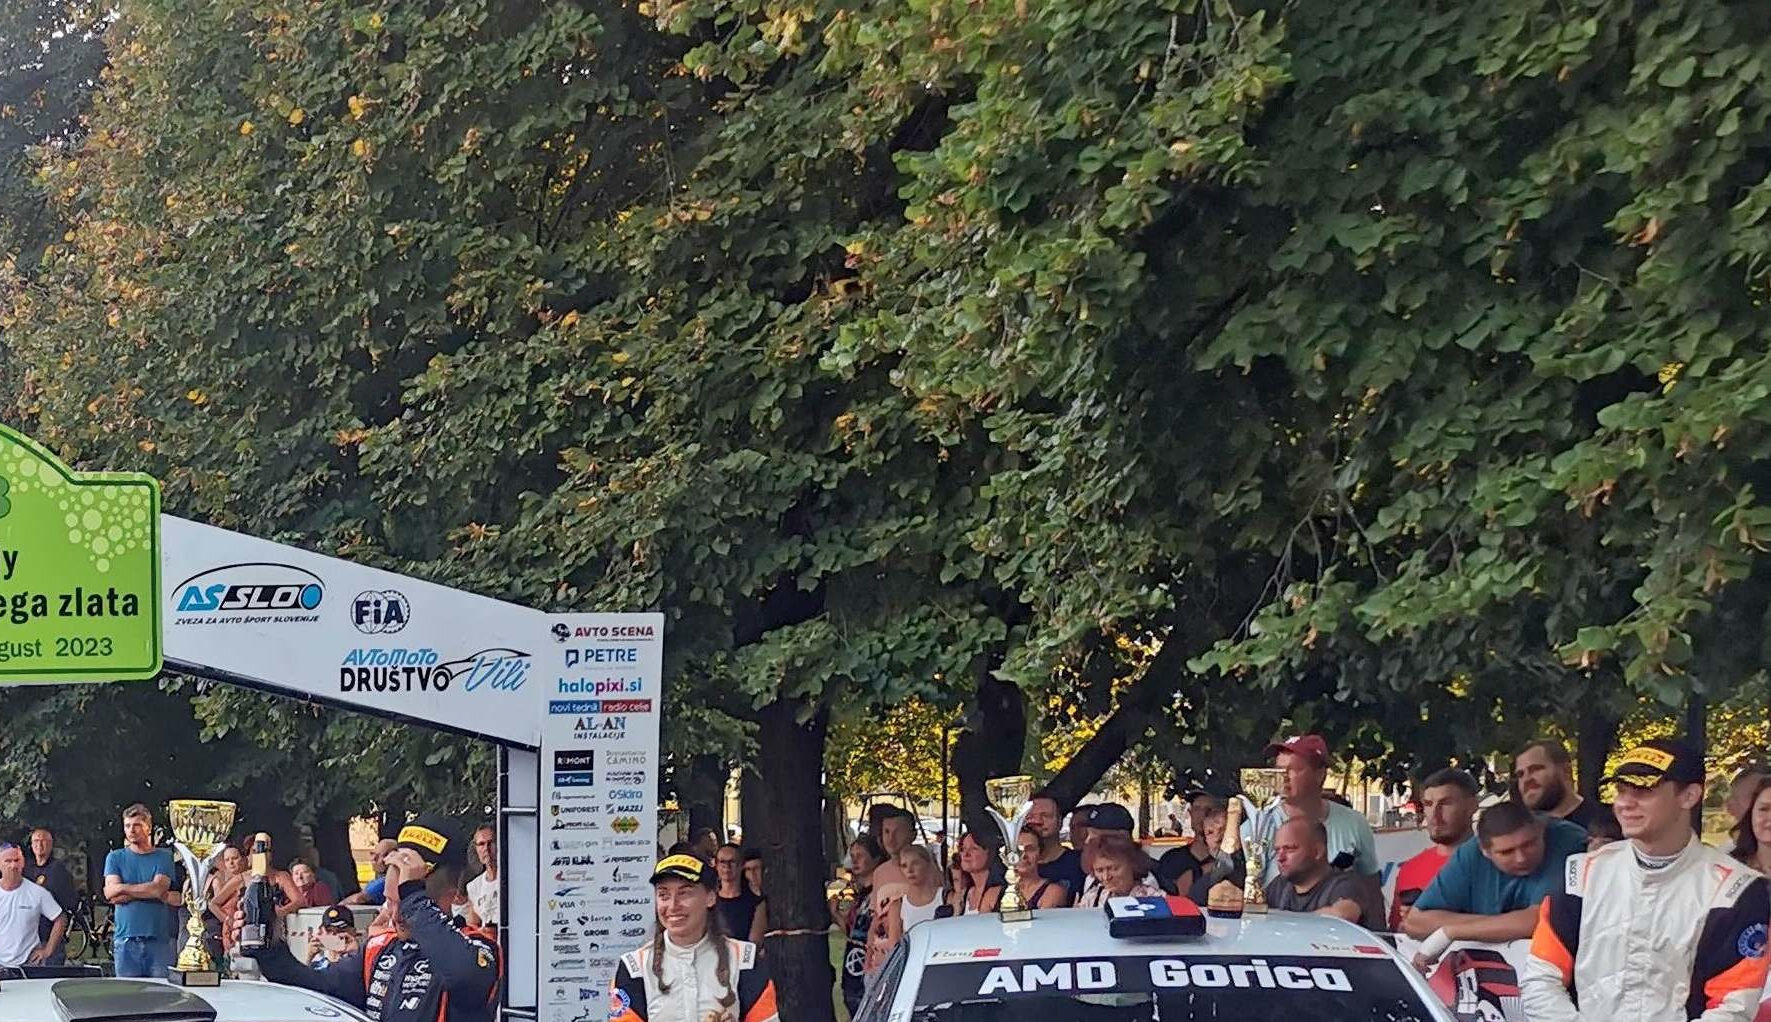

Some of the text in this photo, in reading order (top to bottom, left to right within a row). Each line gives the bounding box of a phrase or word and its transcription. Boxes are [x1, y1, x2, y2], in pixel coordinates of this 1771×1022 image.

[58, 586, 139, 618] zlata
[175, 614, 320, 626] ZVEZA ZA AVTO ŠPORT SLOVENIJE
[575, 626, 654, 637] AVTO SCENA
[55, 637, 114, 658] 2023
[585, 648, 637, 662] PETRE
[340, 663, 452, 693] DRUŠTVO
[559, 677, 642, 696] halopixi.si
[977, 958, 1354, 995] AMD Gorica
